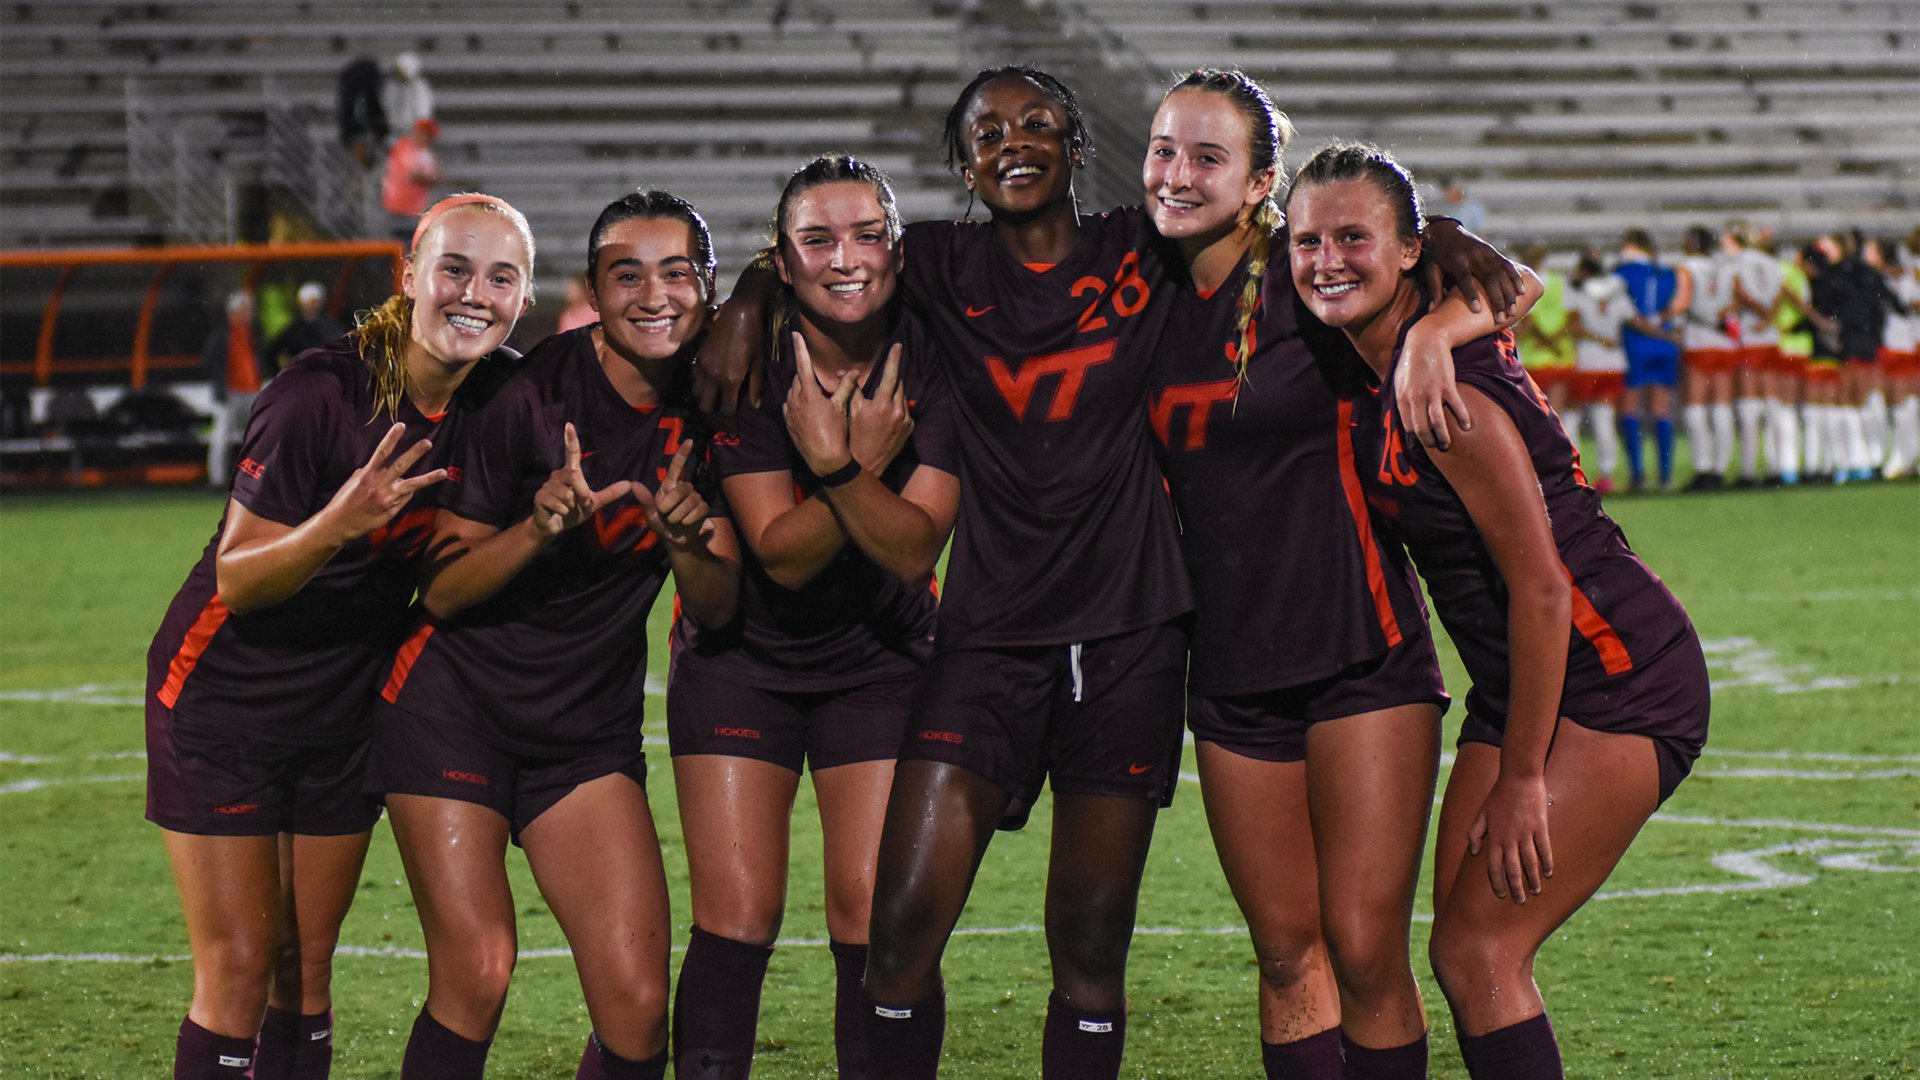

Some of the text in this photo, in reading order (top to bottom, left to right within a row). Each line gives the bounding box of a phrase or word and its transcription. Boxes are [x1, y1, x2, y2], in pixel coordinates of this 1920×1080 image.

[1071, 251, 1151, 333] 28
[984, 337, 1118, 423] VT
[1148, 377, 1244, 451] VT
[236, 457, 267, 480] ACC
[714, 726, 761, 739] HOKIES
[918, 730, 963, 744] HOKIES
[442, 769, 488, 786] HOKIES
[213, 804, 258, 814] HOKIES
